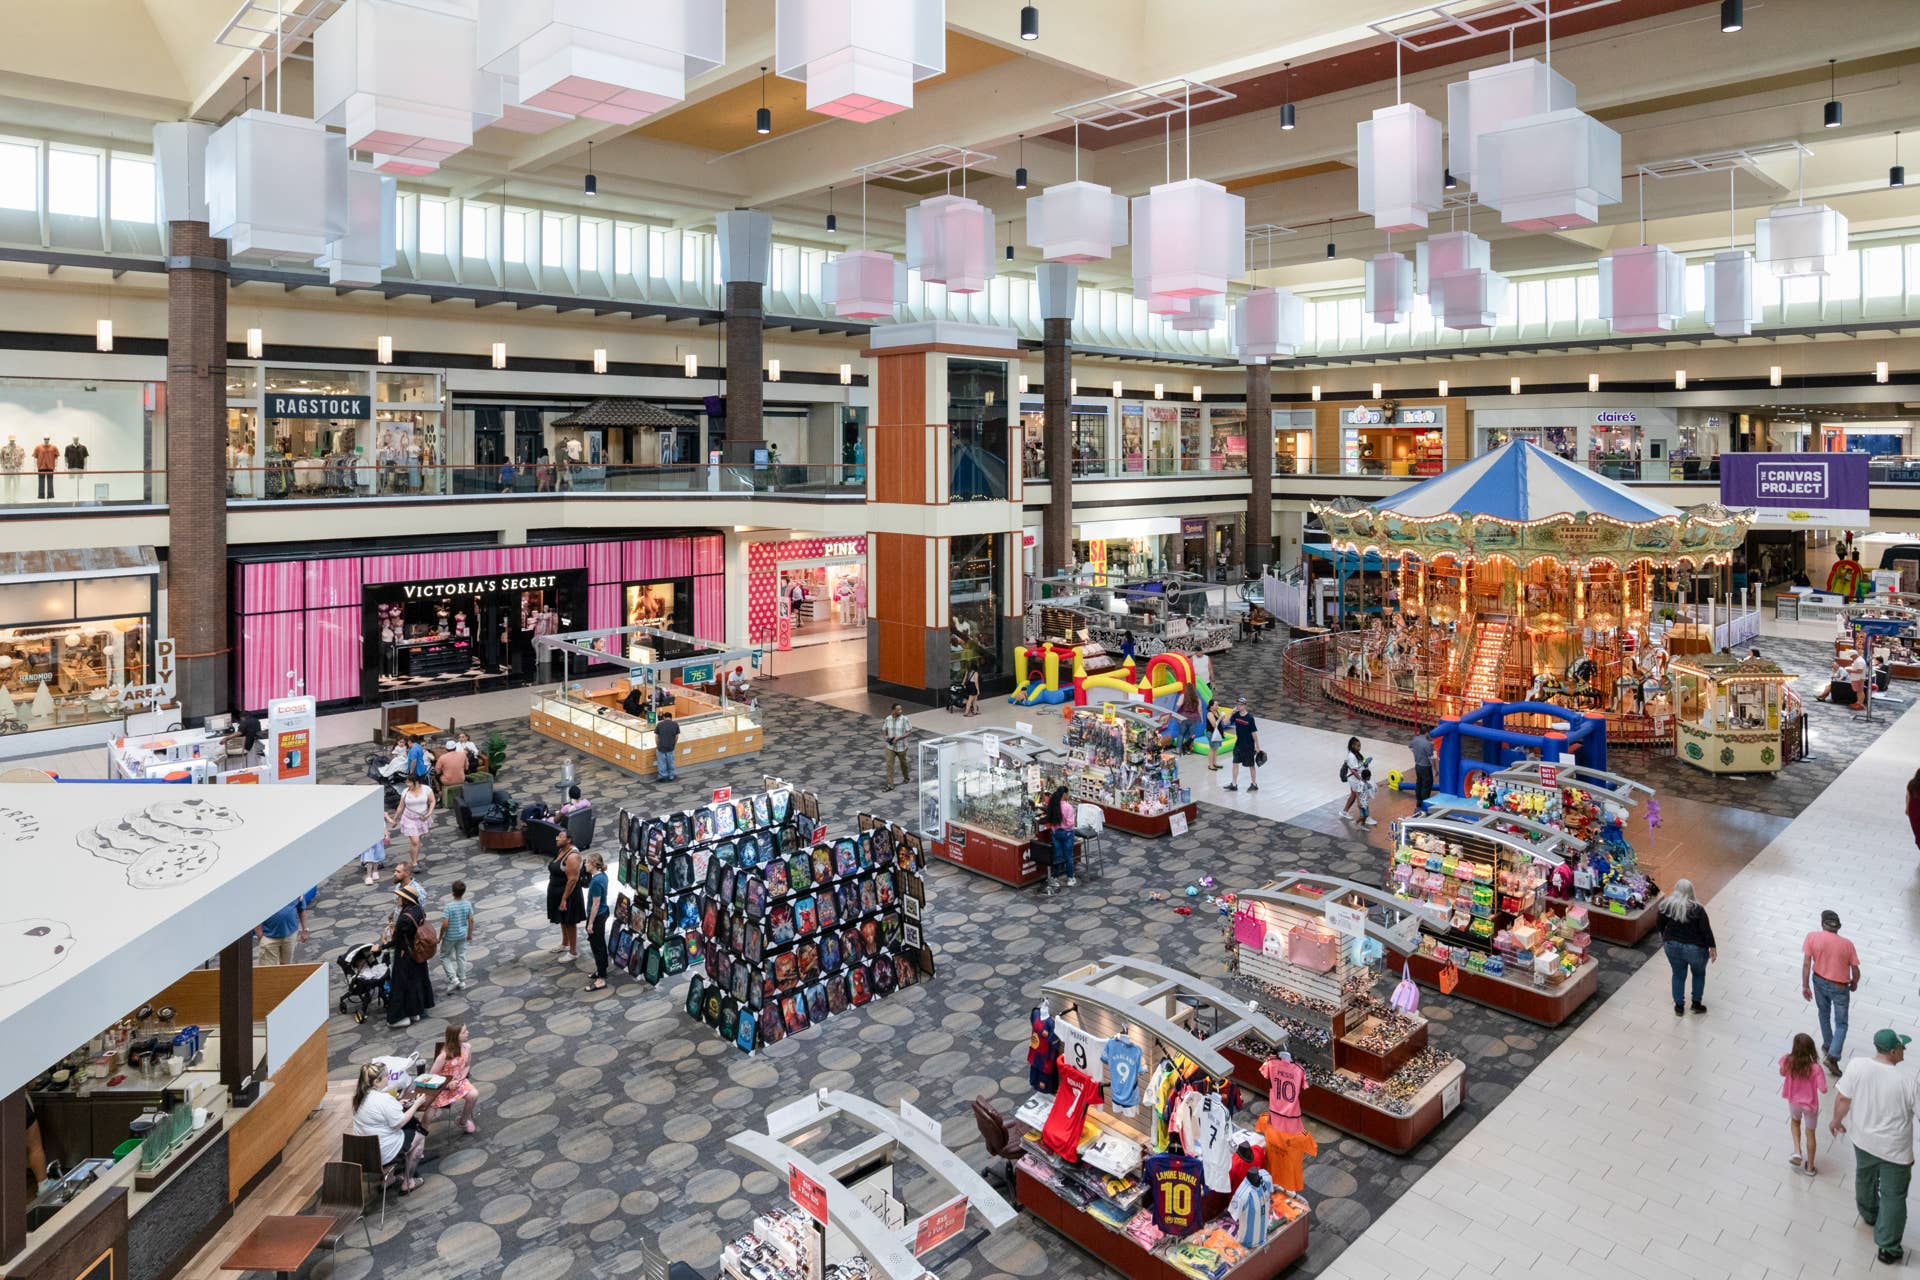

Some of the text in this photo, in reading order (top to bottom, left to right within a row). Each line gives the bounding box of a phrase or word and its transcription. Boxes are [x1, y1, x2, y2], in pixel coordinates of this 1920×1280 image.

[276, 398, 361, 415] RAGSTOCK
[1597, 411, 1637, 422] claire's
[1768, 470, 1822, 482] CANVAS
[1761, 482, 1822, 494] PROJECT
[824, 541, 859, 557] PINK
[403, 575, 557, 599] VICTORIA'S SECRET
[157, 641, 174, 684] DIY
[123, 685, 167, 702] AREA
[1074, 1042, 1087, 1070] 9
[1116, 1062, 1130, 1084] 9
[1273, 1077, 1296, 1103] 10
[1066, 1087, 1082, 1118] 7
[1208, 1124, 1218, 1150] 7
[1160, 1181, 1192, 1216] 10
